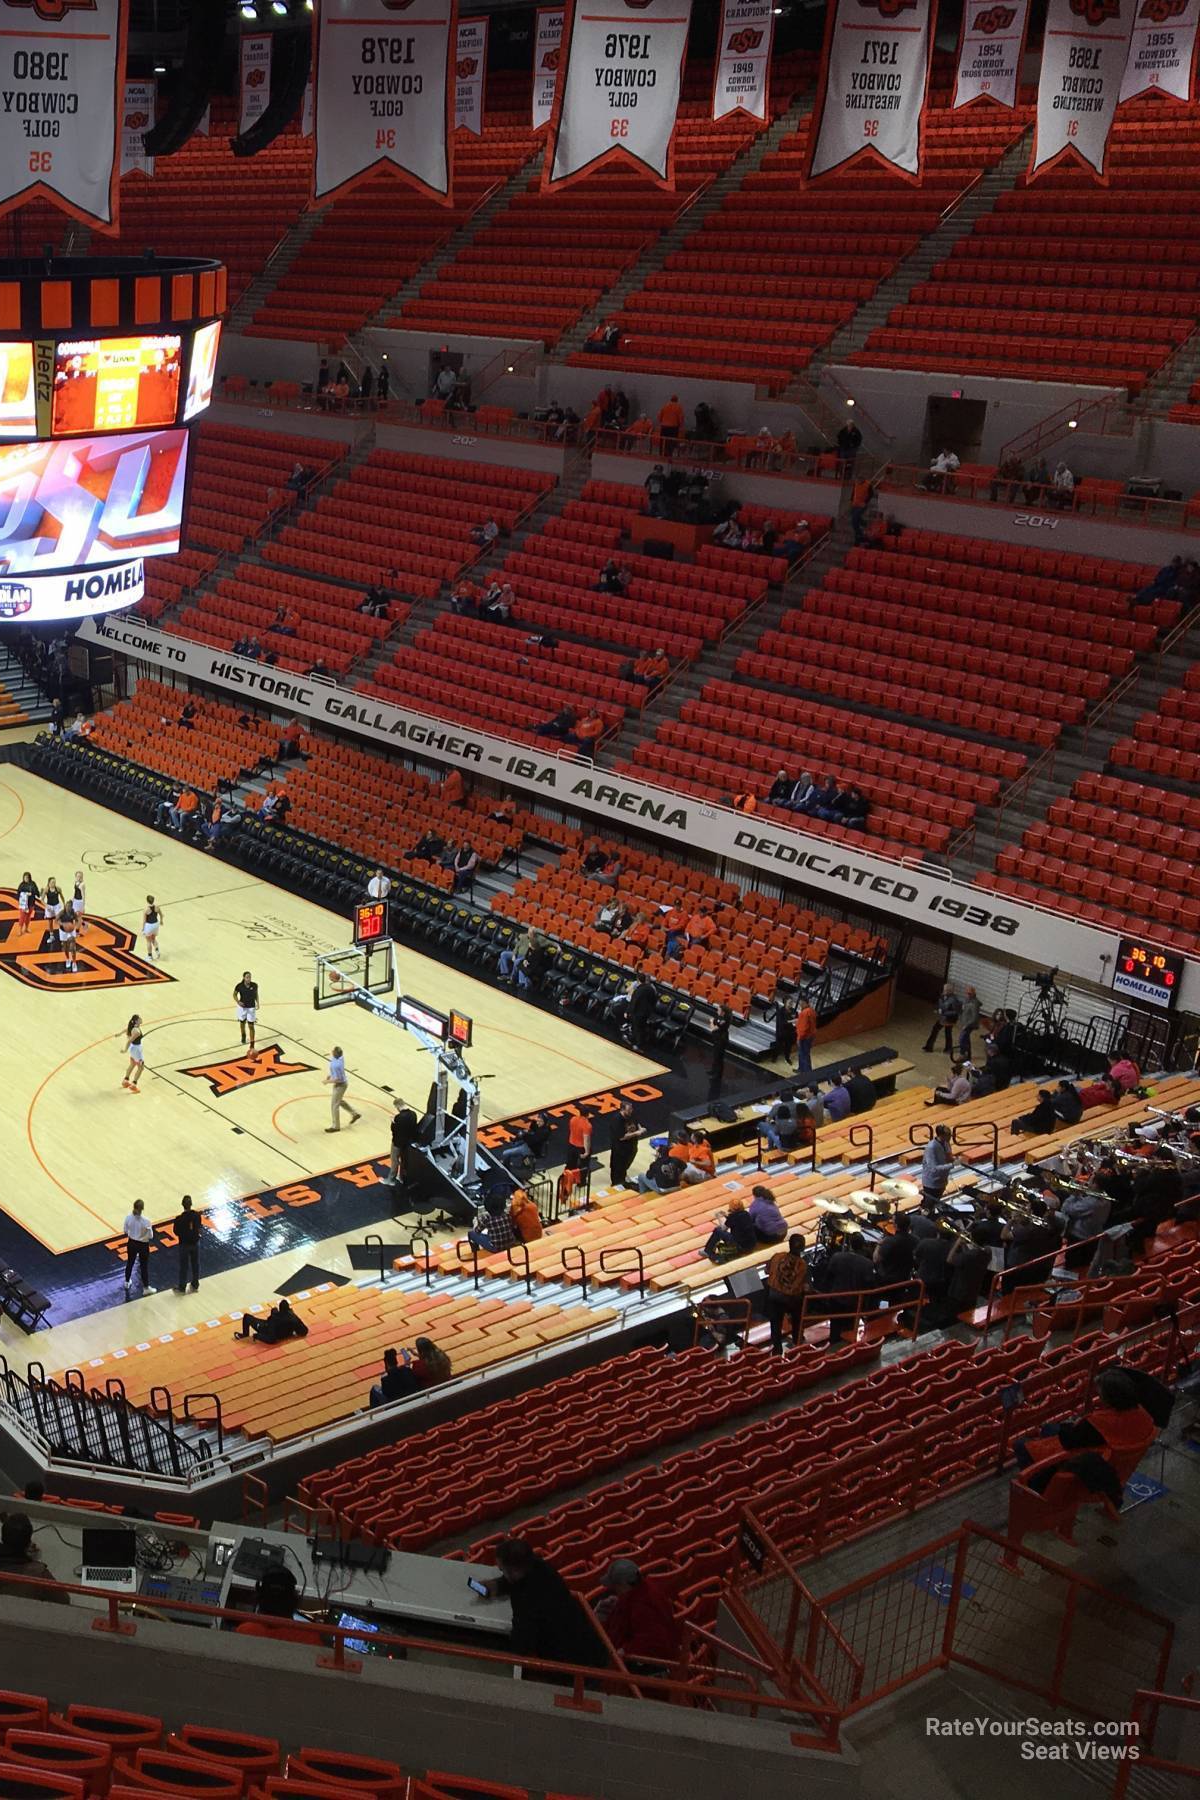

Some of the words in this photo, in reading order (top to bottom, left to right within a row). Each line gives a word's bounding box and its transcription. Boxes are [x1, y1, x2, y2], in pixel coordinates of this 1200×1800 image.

[725, 7, 770, 18] CHAMPIONS
[1146, 33, 1174, 46] 1955
[978, 44, 1003, 57] 1954
[1138, 48, 1178, 60] COWBOY
[972, 59, 1005, 69] COWBOY
[1134, 59, 1180, 70] WRESTLING
[961, 69, 982, 78] CROSS
[983, 68, 1014, 78] COUNTRY
[728, 76, 756, 85] COWBOY
[725, 85, 757, 93] WRESTLING
[38, 344, 53, 402] Hertz
[451, 434, 478, 447] 202
[1014, 514, 1060, 529] 204
[96, 625, 163, 655] WELCOME
[167, 646, 187, 663] TO
[210, 660, 314, 706] HISTORIC
[570, 779, 688, 830] ARENA
[733, 830, 919, 903] DEDICATED
[928, 895, 1020, 937] 1938
[359, 903, 384, 920] 36:10
[1145, 967, 1151, 977] 1
[1115, 975, 1169, 1000] HOMELAND
